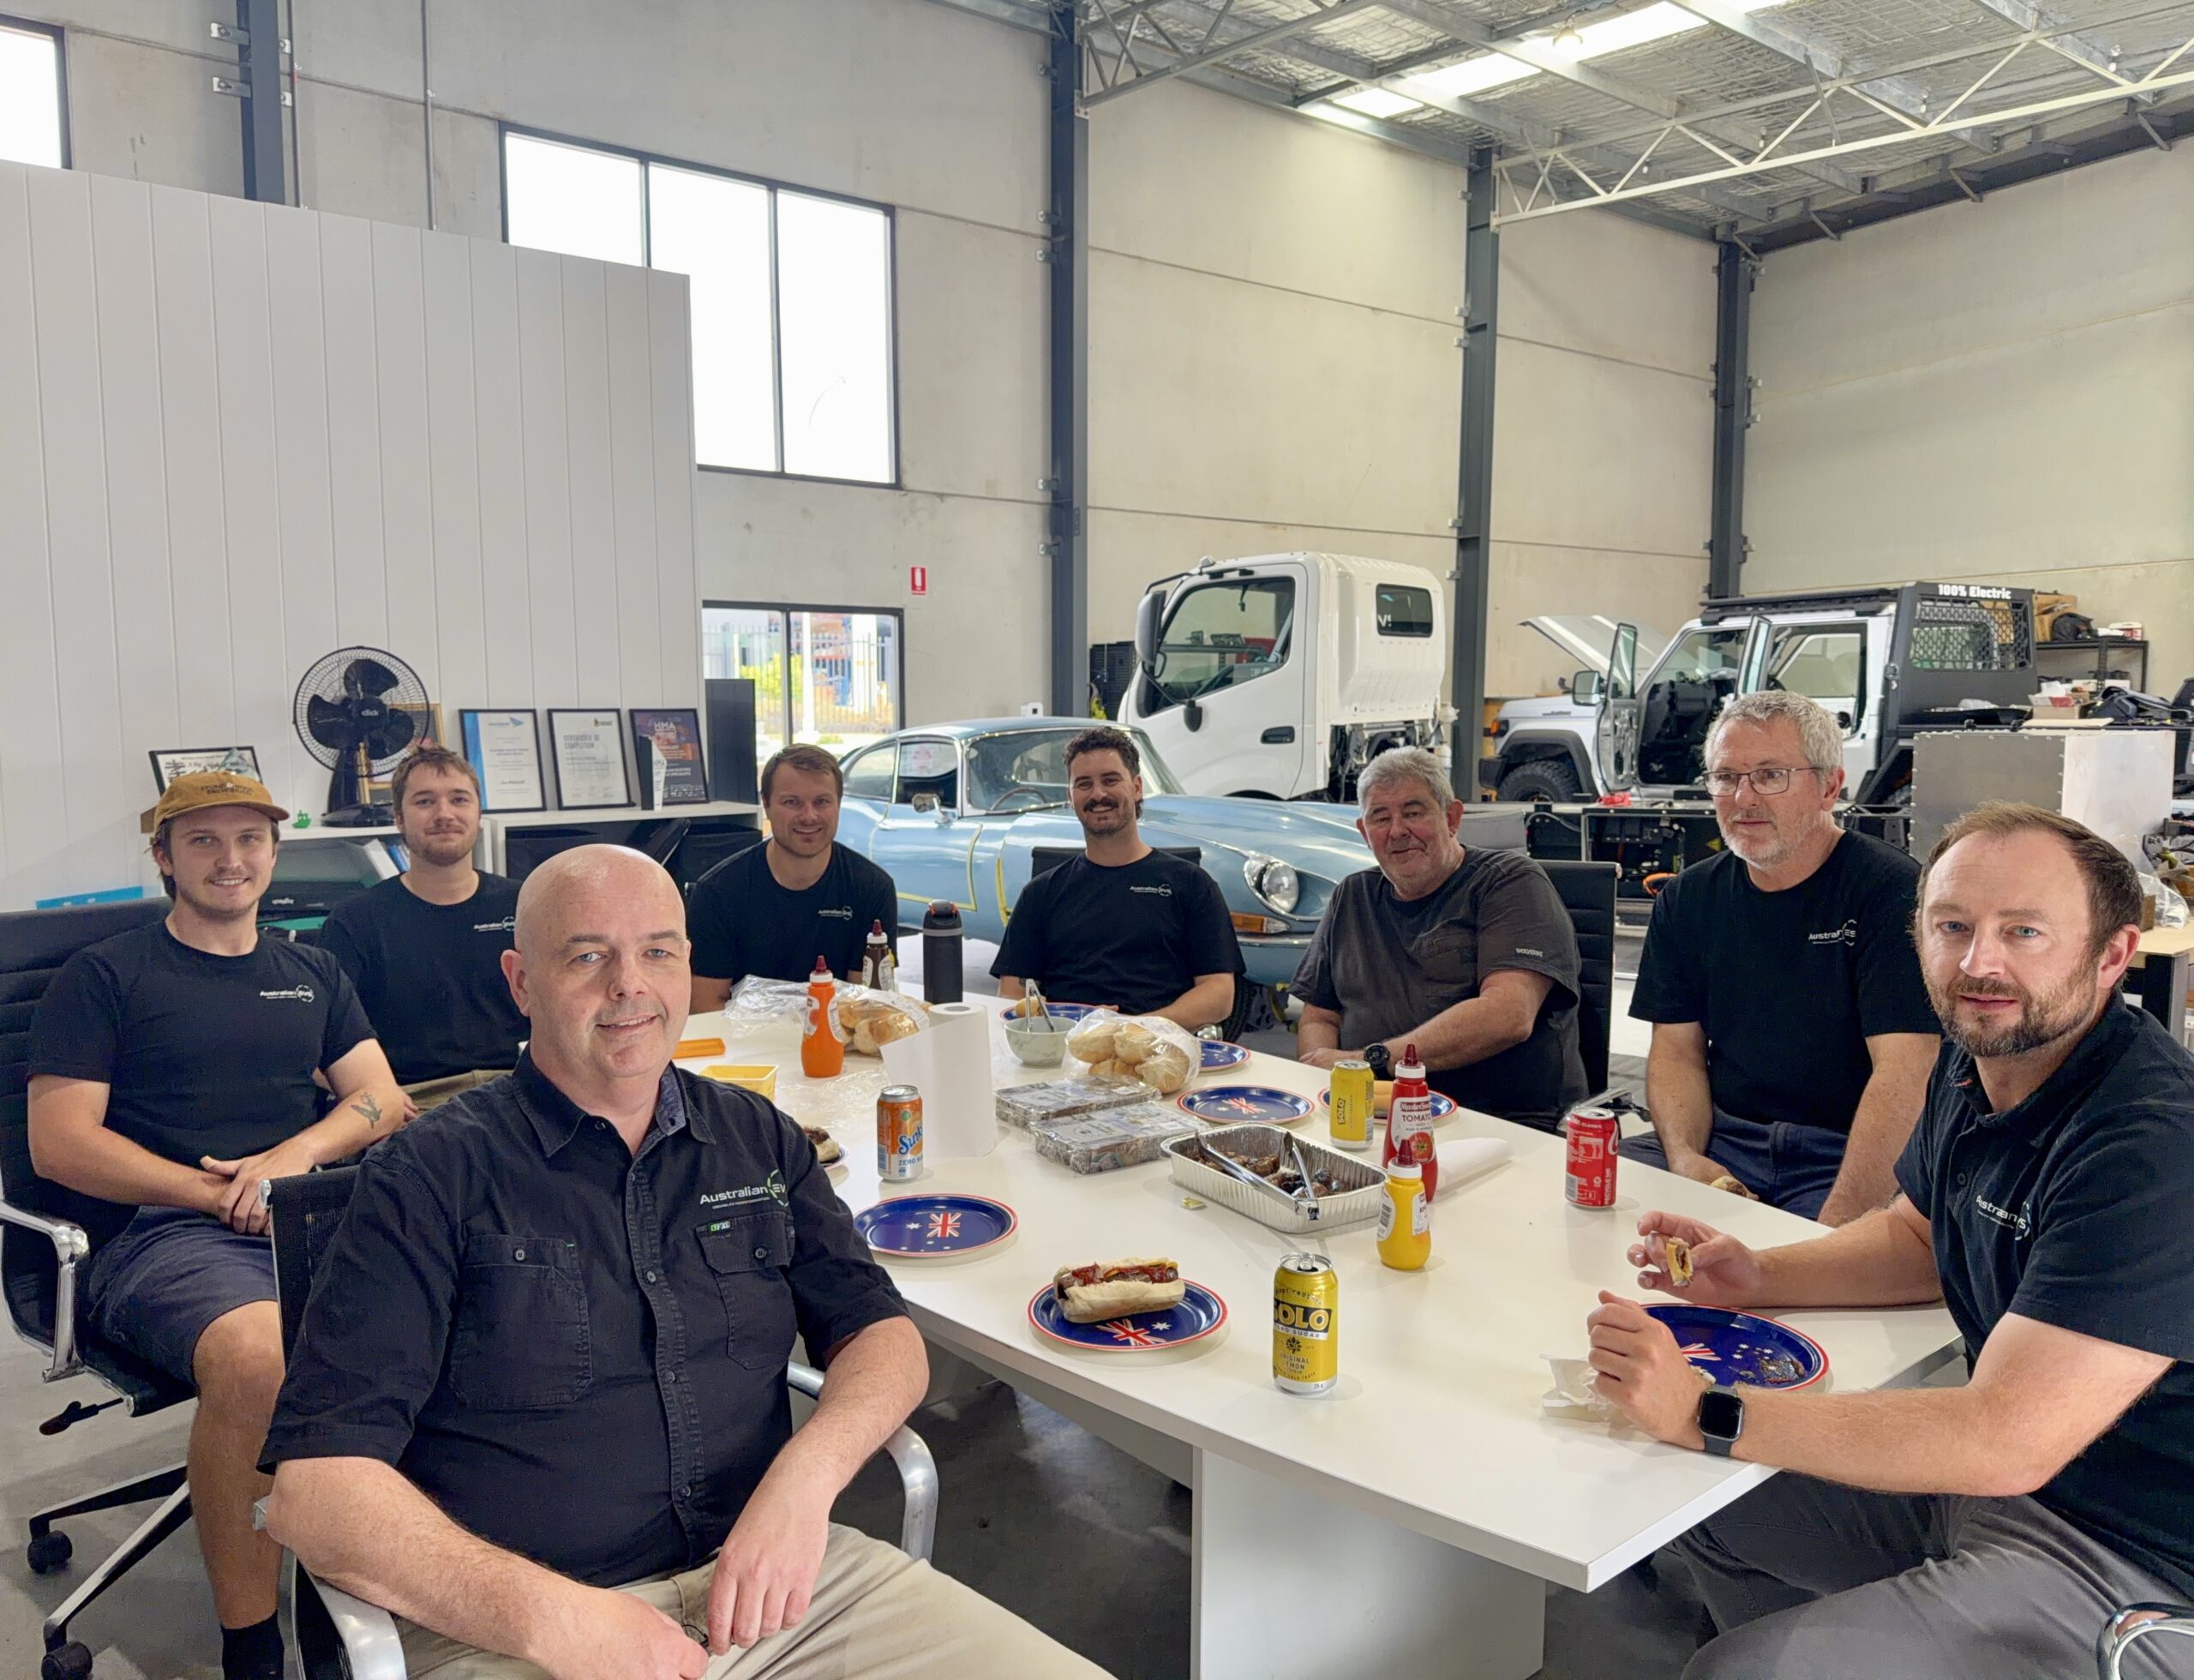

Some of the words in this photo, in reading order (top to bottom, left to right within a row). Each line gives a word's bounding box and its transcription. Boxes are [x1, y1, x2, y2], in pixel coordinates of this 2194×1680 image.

[1938, 584, 1967, 597] 100%
[1969, 585, 2012, 599] Electric
[898, 1158, 916, 1167] ZERO
[699, 1185, 769, 1205] Australian
[1292, 1329, 1320, 1339] SUGAR
